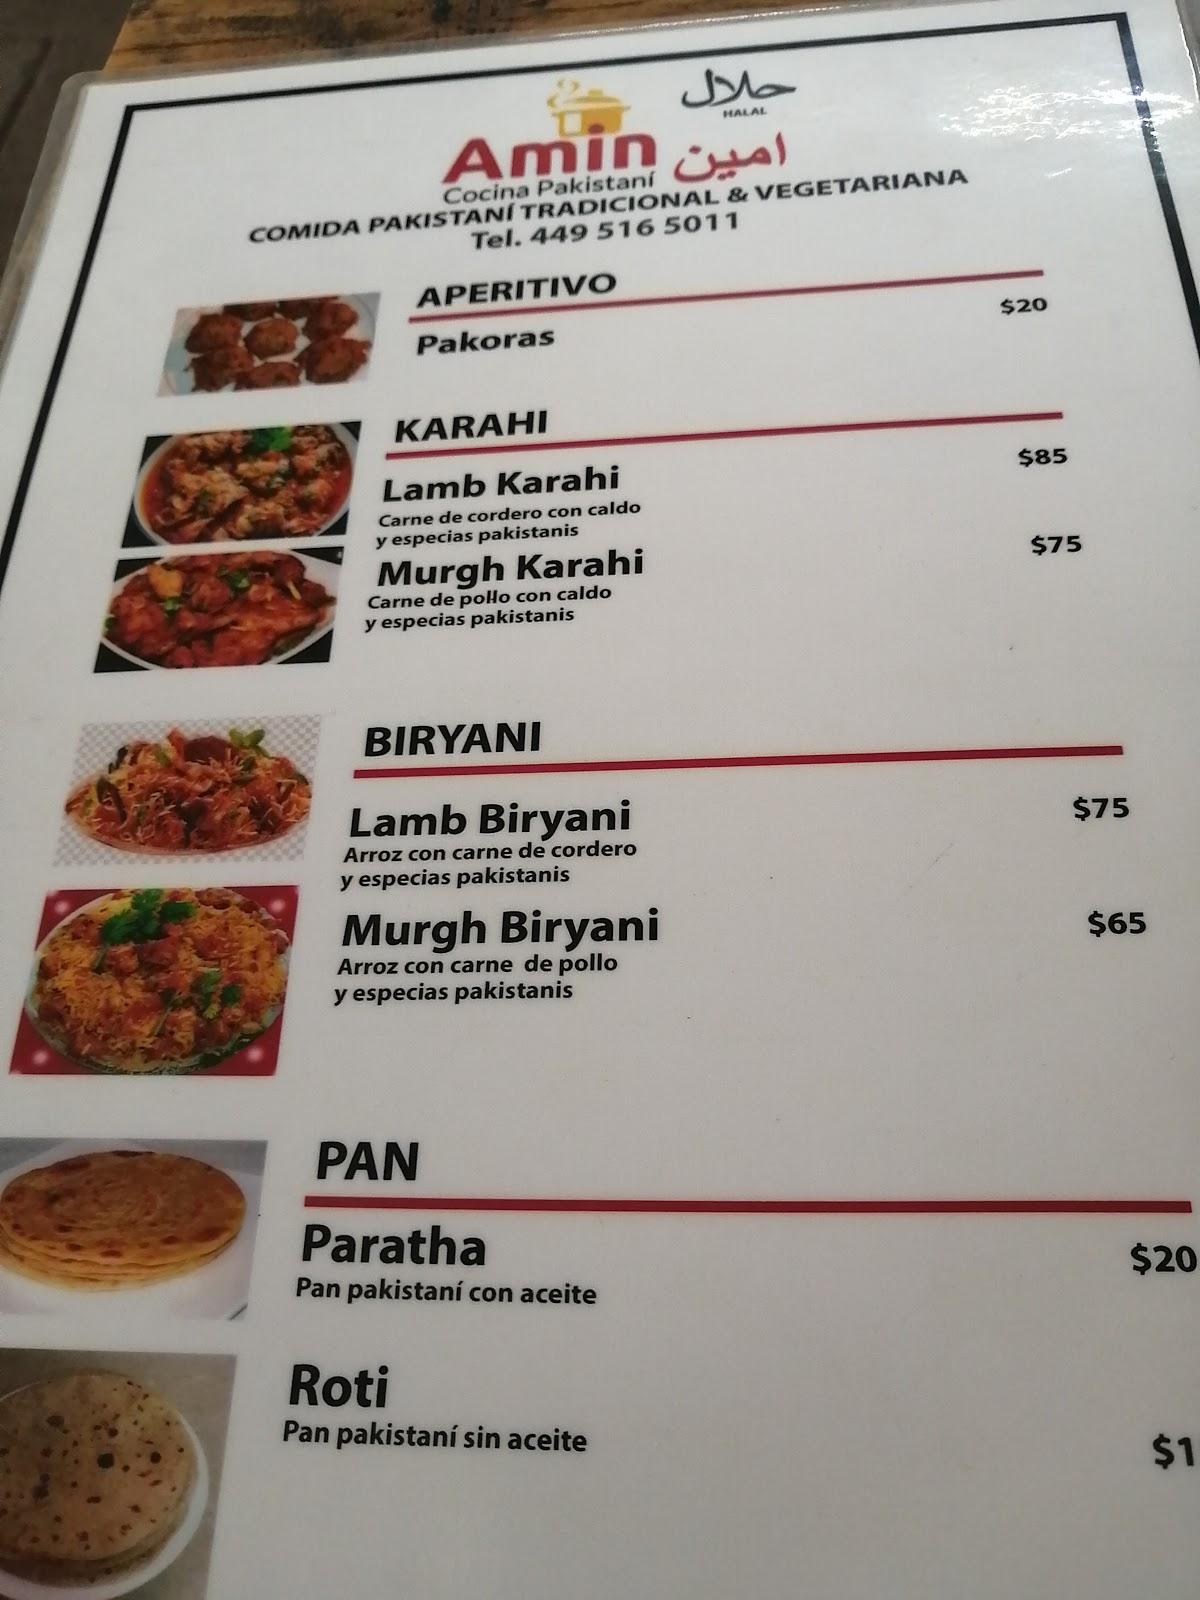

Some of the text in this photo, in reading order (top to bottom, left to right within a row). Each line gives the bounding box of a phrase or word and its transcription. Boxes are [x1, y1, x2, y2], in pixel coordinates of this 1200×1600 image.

[680, 68, 797, 109] حلال
[722, 106, 767, 119] HALAL
[442, 123, 656, 184] Amin
[442, 170, 655, 205] Cocina Pakistaní
[248, 168, 969, 244] COMIDA PAKISTANÍ TRADICIONAL & VEGETARIANA
[470, 211, 738, 250] Tel. 449 516 5011
[416, 272, 617, 309] APERITIVO
[999, 297, 1048, 316] $20
[416, 330, 555, 356] Pakoras
[394, 410, 548, 444] KARAHI
[1017, 447, 1068, 468] $85
[382, 464, 620, 503] Lamb Karahi
[378, 500, 641, 528] Carne de cordero con caldo
[375, 523, 579, 551] y especias pakistanis
[1030, 534, 1082, 557] $75
[377, 547, 644, 591] Murgh Karahi
[367, 584, 612, 610] Carne de pollo con caldo
[364, 607, 575, 634] y especias pakistanis
[364, 721, 541, 758] BIRYANI
[349, 798, 631, 842] Lamb Biryani
[1072, 796, 1130, 822] $75
[343, 839, 637, 864] Arroz con carne de cordero
[340, 865, 570, 893] y especias pakistanis
[341, 907, 659, 955] Murgh Biryani
[1087, 910, 1147, 938] $65
[336, 952, 618, 977] Arroz con carne de pollo
[333, 980, 573, 1007] y especias pakistanis
[316, 1140, 420, 1182] PAN
[301, 1223, 486, 1267] Paratha
[1130, 1242, 1198, 1276] $20
[295, 1276, 597, 1305] Pan pakistaní con aceite
[289, 1363, 389, 1409] Roti
[282, 1419, 588, 1453] Pan pakistaní sin aceite
